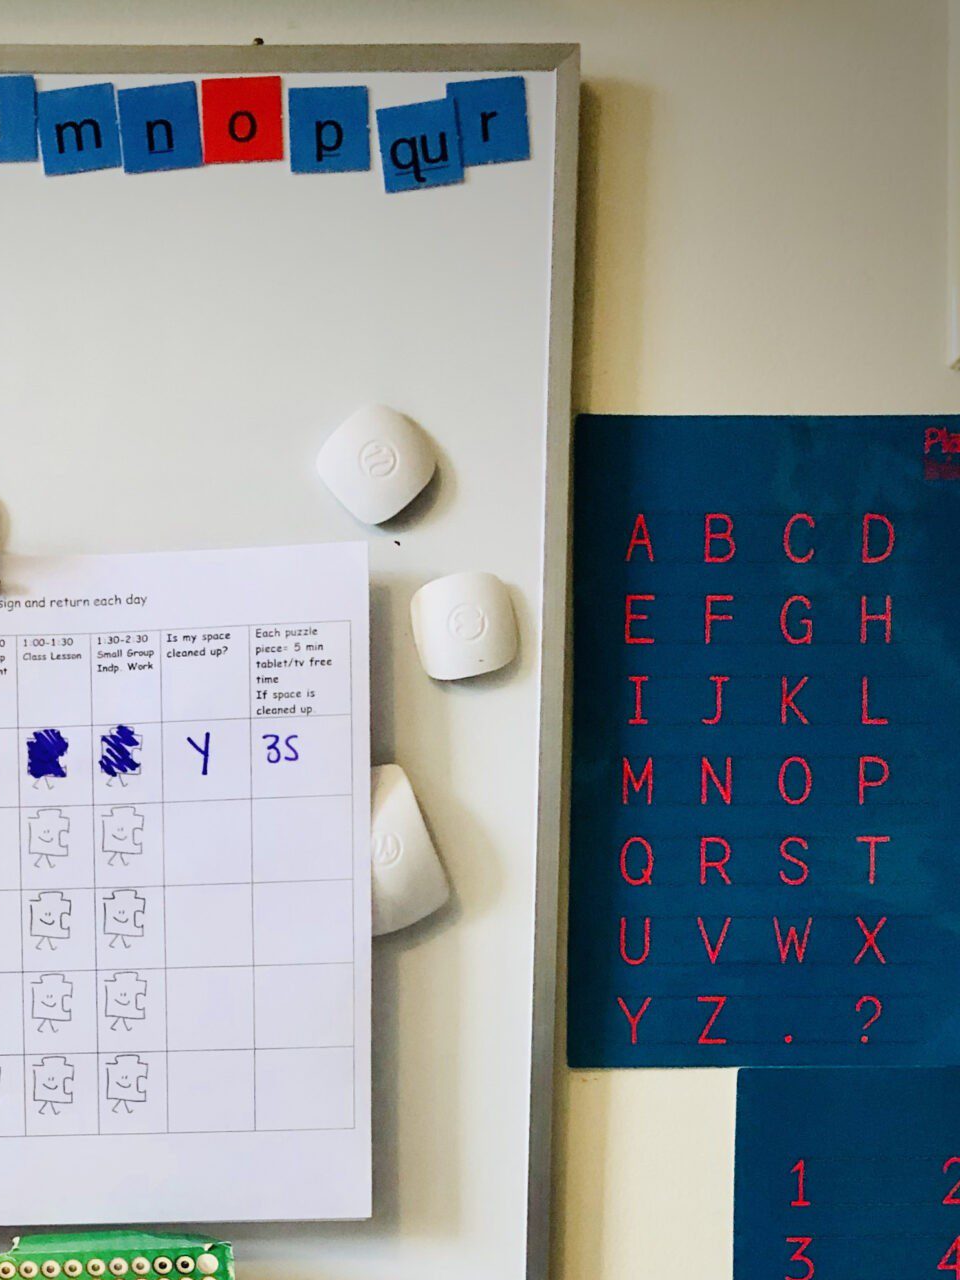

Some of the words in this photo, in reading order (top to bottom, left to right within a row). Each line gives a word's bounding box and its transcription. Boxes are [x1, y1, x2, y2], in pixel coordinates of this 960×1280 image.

[55, 118, 102, 154] m
[146, 118, 174, 153] n
[228, 110, 257, 142] o
[315, 119, 344, 162] p
[390, 131, 449, 183] qu
[480, 108, 498, 143] r
[626, 513, 654, 562] A
[704, 513, 736, 563] B
[783, 513, 815, 563] C
[862, 513, 895, 564] D
[25, 598, 45, 609] and
[50, 596, 89, 608] return
[94, 595, 121, 607] each
[126, 593, 148, 607] day
[625, 594, 655, 644] E
[705, 594, 734, 644] F
[780, 595, 813, 645] G
[860, 595, 892, 644] H
[166, 633, 178, 643] Is
[183, 633, 197, 645] my
[202, 632, 231, 644] space
[255, 626, 280, 638] Each
[285, 626, 318, 639] puzzle
[23, 637, 73, 647] 1:00-1:30
[97, 634, 148, 645] 1:30-2:30
[97, 649, 123, 659] Small
[127, 648, 155, 661] Group
[166, 647, 206, 659] cleaned
[209, 646, 228, 659] up?
[255, 643, 288, 655] piece=
[294, 642, 302, 652] 5
[306, 642, 323, 651] min
[23, 651, 50, 661] Class
[55, 650, 82, 660] Lesson
[97, 662, 120, 675] Indp.
[128, 661, 153, 671] Work
[256, 658, 304, 670] tablet/tv
[310, 657, 332, 668] free
[256, 674, 279, 684] time
[256, 689, 268, 699] If
[272, 691, 301, 702] space
[306, 689, 315, 698] is
[628, 675, 648, 725] I
[702, 675, 730, 725] J
[781, 677, 809, 724] K
[861, 677, 889, 725] L
[256, 704, 295, 716] cleaned
[622, 757, 653, 805] M
[701, 757, 732, 805] N
[778, 756, 812, 805] O
[858, 755, 890, 805] P
[619, 836, 654, 886] Q
[700, 836, 732, 885] R
[779, 836, 809, 886] S
[856, 835, 890, 884] T
[619, 917, 651, 965] U
[697, 917, 731, 965] V
[773, 917, 812, 963] W
[854, 916, 887, 965] X
[617, 996, 652, 1044] Y
[697, 995, 727, 1045] Z
[855, 995, 883, 1044] ?
[790, 1159, 811, 1207] 1
